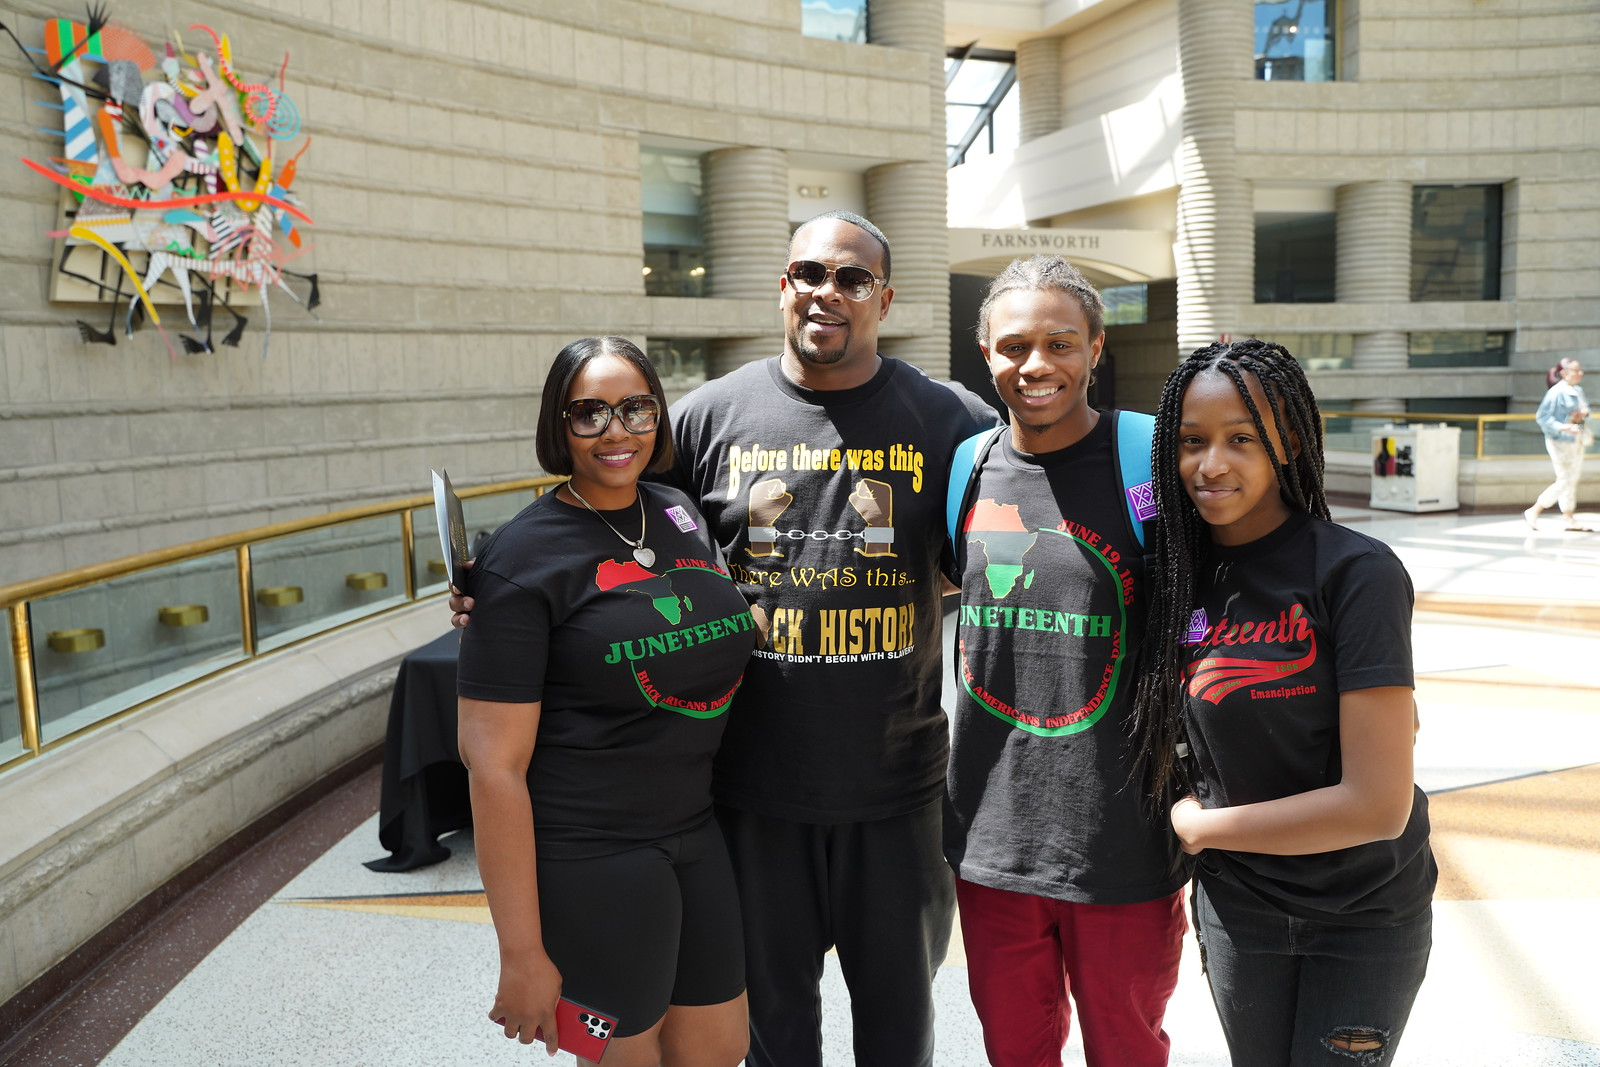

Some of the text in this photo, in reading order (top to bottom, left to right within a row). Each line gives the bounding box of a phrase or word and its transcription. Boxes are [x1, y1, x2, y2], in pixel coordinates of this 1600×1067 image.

[981, 233, 1100, 249] FARNSWORTH
[727, 443, 924, 500] Before there was this
[675, 558, 710, 569] JUNE
[727, 562, 783, 588] There
[790, 566, 857, 591] WAS
[1056, 519, 1135, 606] JUNE 19, 1865
[819, 602, 916, 656] HISTORY
[960, 604, 1112, 637] UNETEENTH
[787, 654, 823, 664] DIDN'T
[825, 654, 858, 664] BEGIN
[860, 651, 885, 662] WITH
[887, 644, 916, 660] SLAVERY
[1275, 662, 1300, 673] 1865
[637, 670, 662, 702] BLACK
[972, 686, 1041, 728] AMERICANS
[1044, 663, 1115, 729] INDEPENDENCE
[1110, 630, 1121, 660] DAY
[1250, 685, 1317, 699] Emancipation
